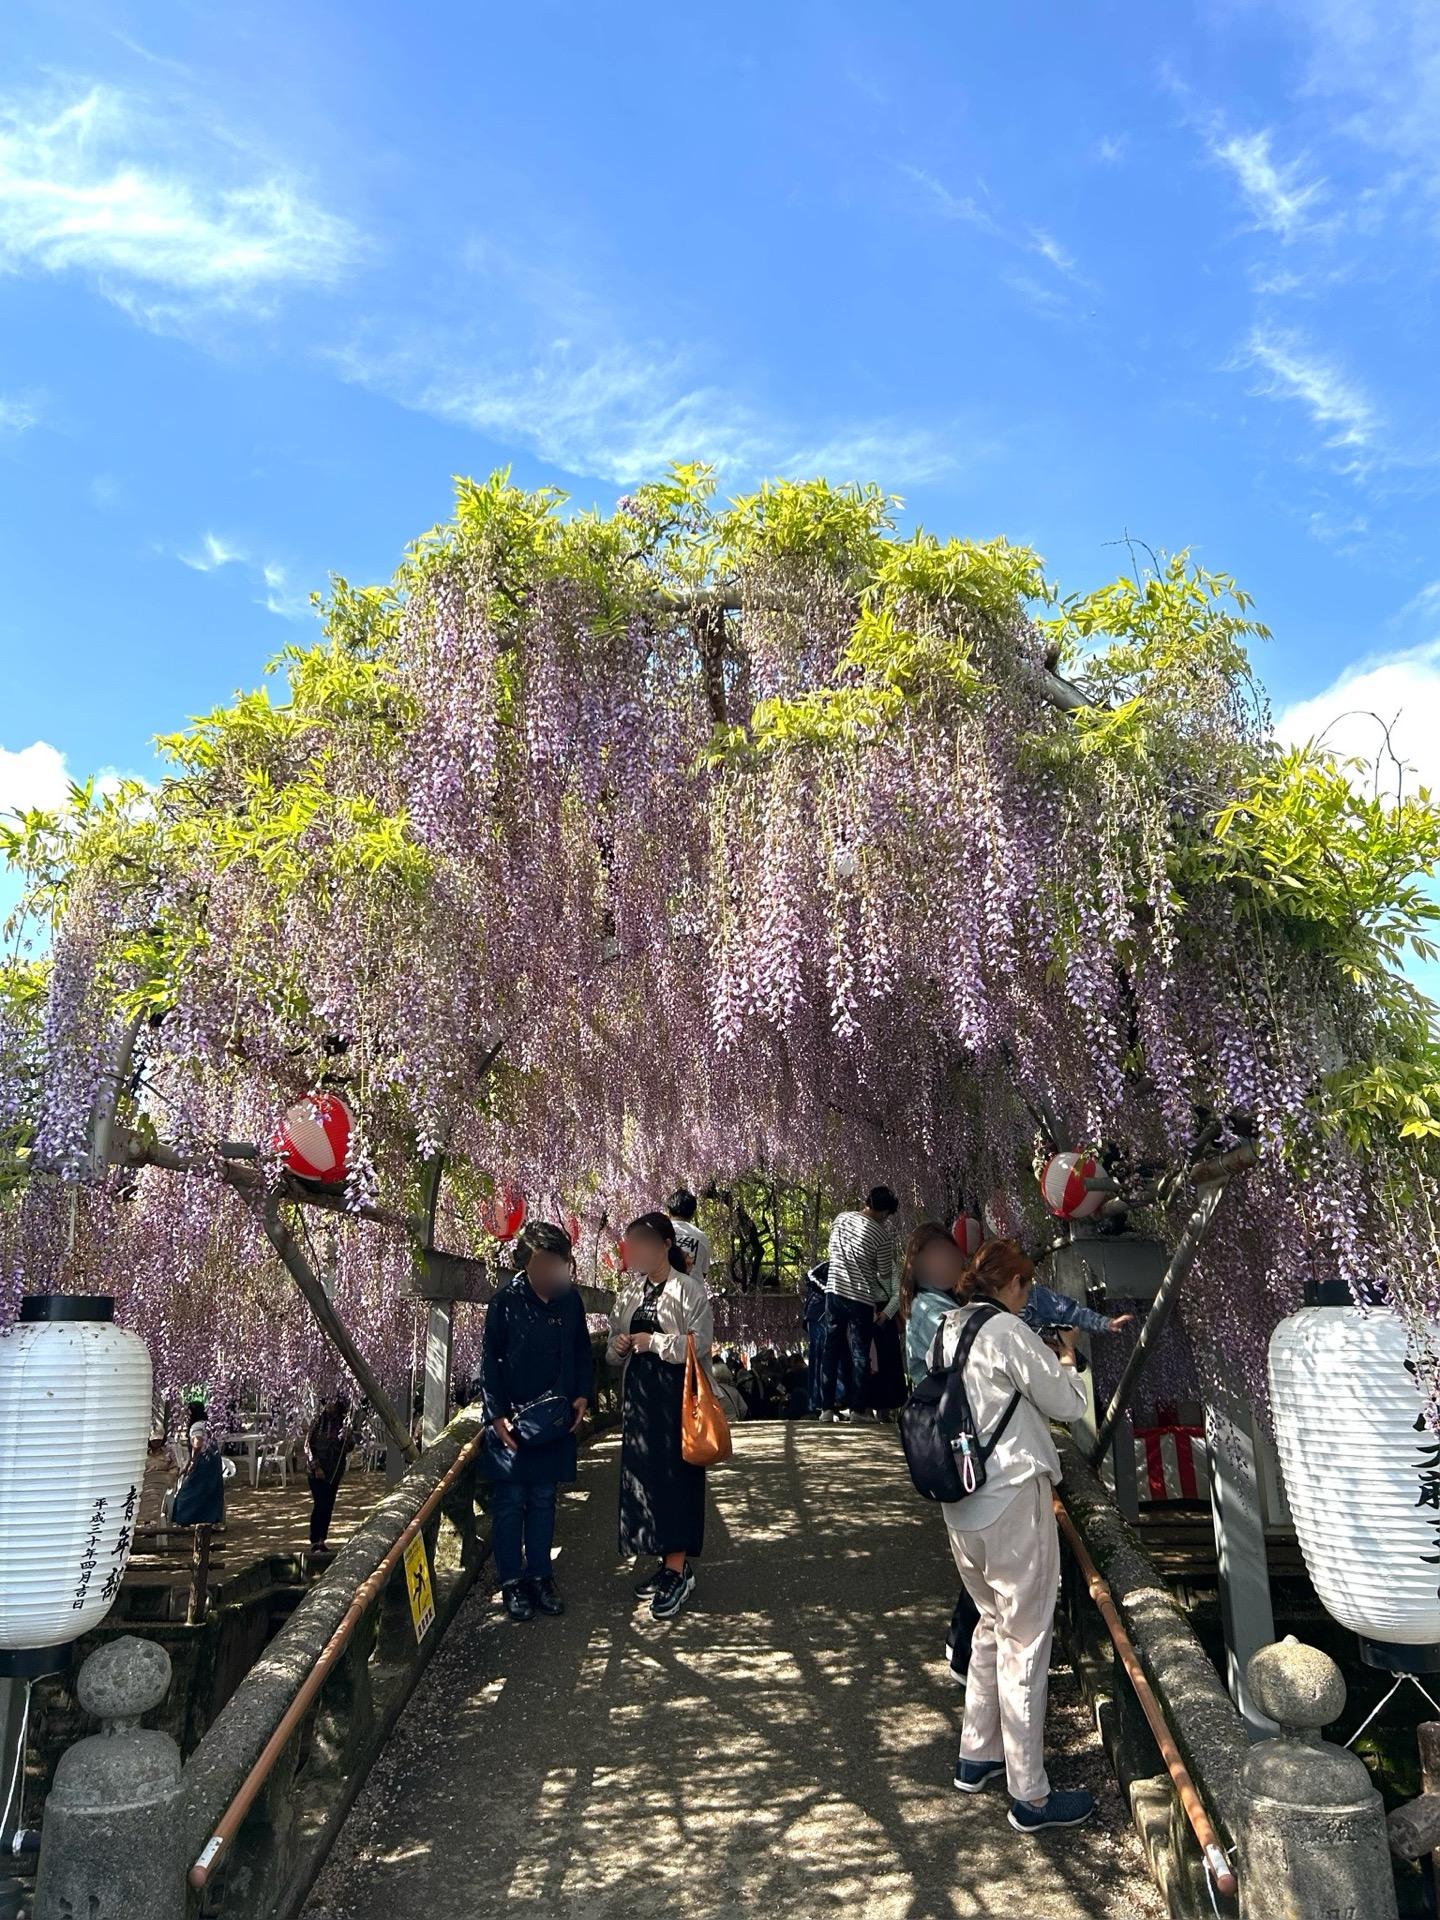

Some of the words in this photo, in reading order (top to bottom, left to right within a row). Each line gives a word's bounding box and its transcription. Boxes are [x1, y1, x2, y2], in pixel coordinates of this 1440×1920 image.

[72, 1497, 108, 1610] 平成三十年四月吉日
[101, 1485, 138, 1602] 青年部
